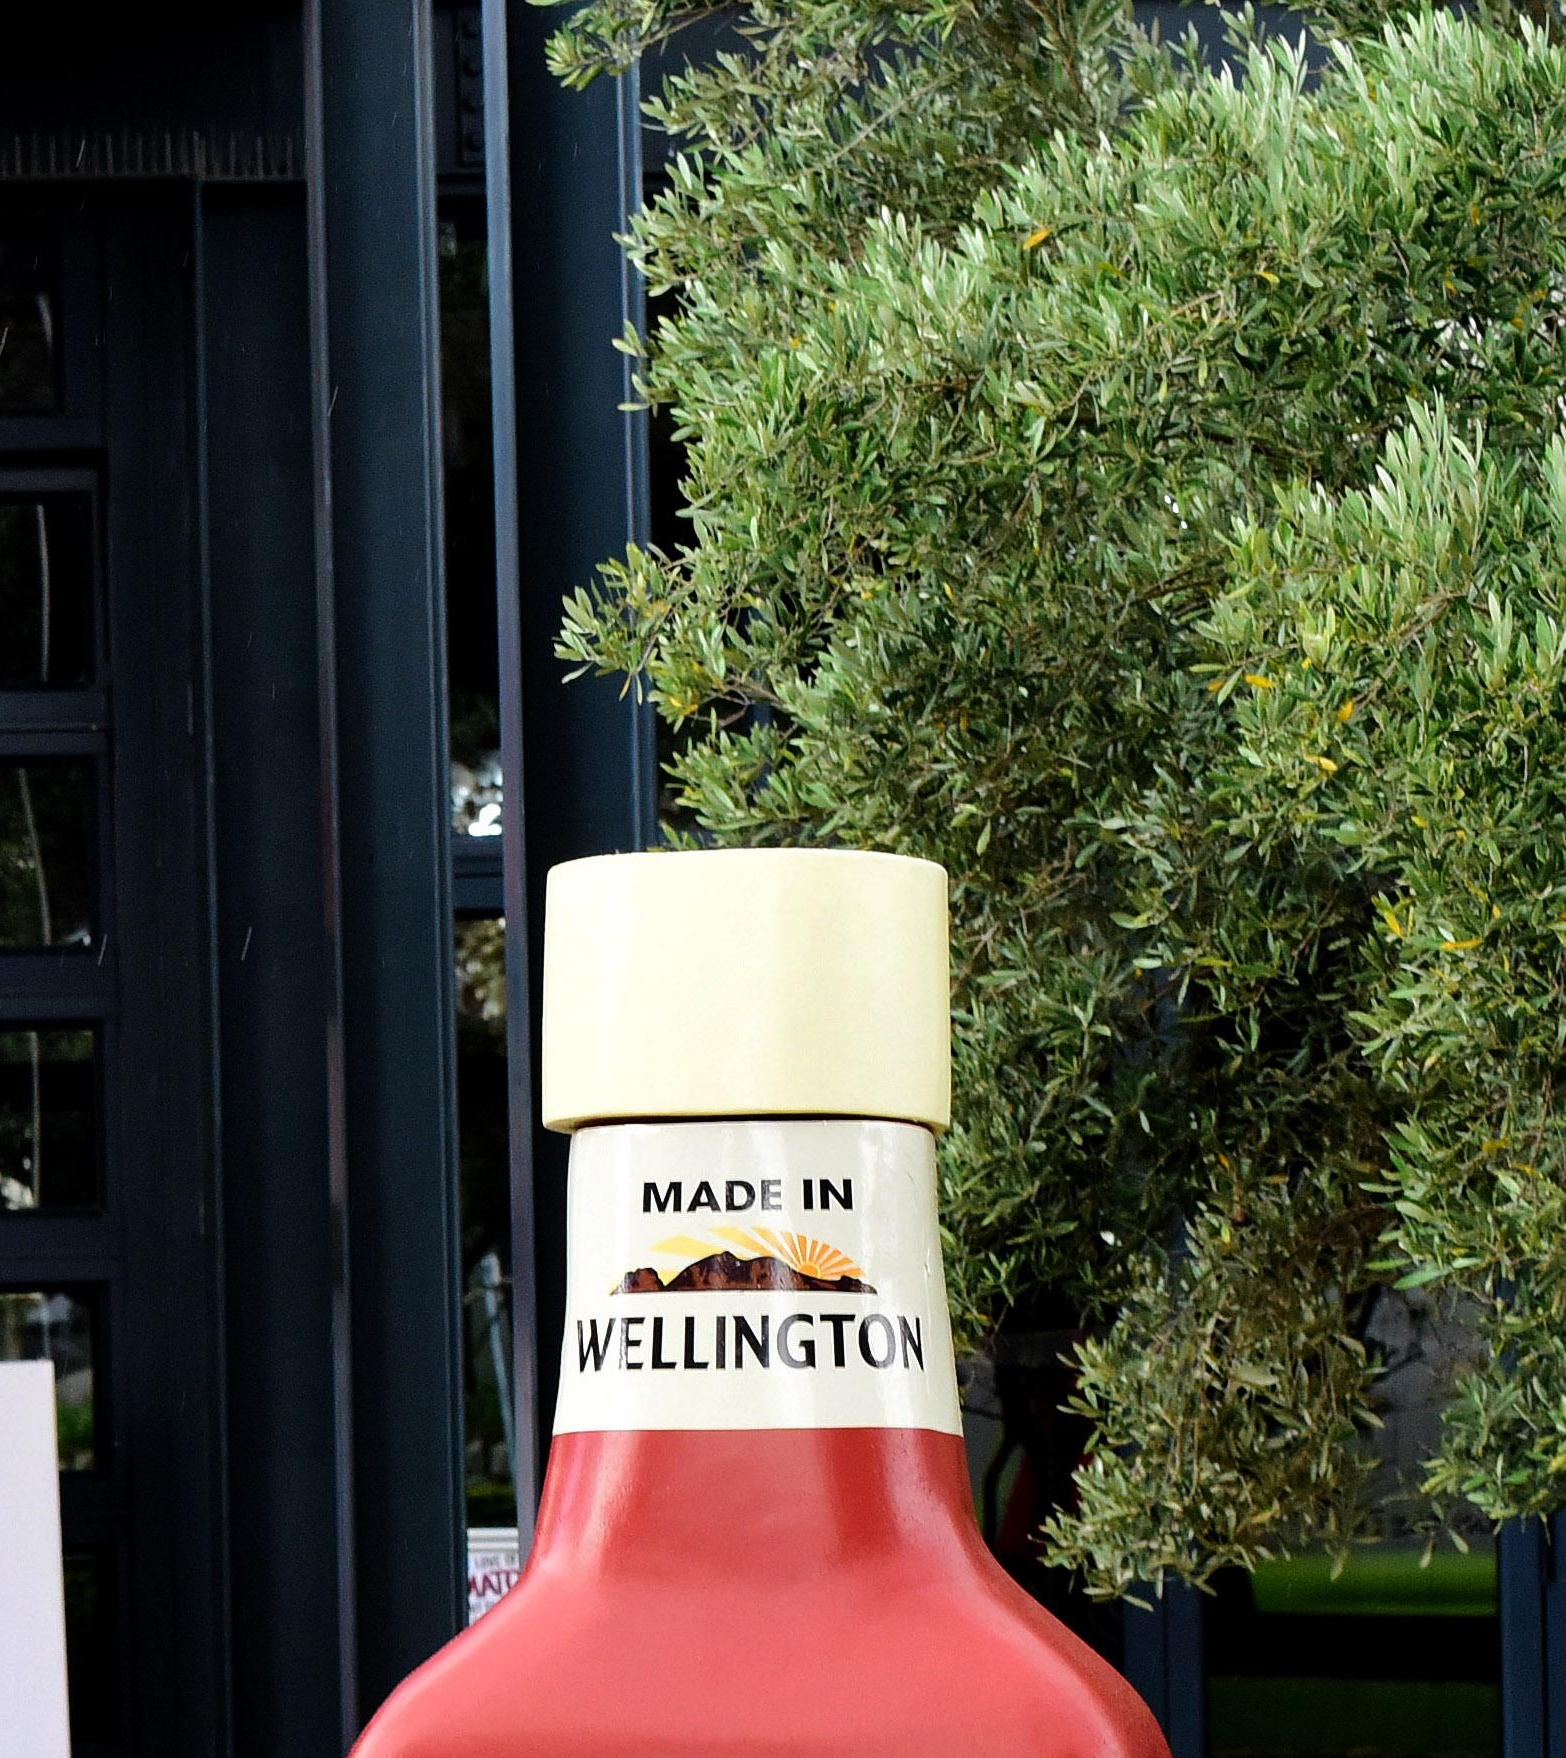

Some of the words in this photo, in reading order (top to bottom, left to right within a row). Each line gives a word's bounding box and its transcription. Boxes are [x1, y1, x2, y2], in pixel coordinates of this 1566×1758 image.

[642, 1179, 782, 1213] MADE
[802, 1178, 853, 1211] IN
[576, 1313, 925, 1373] WELLINGTON
